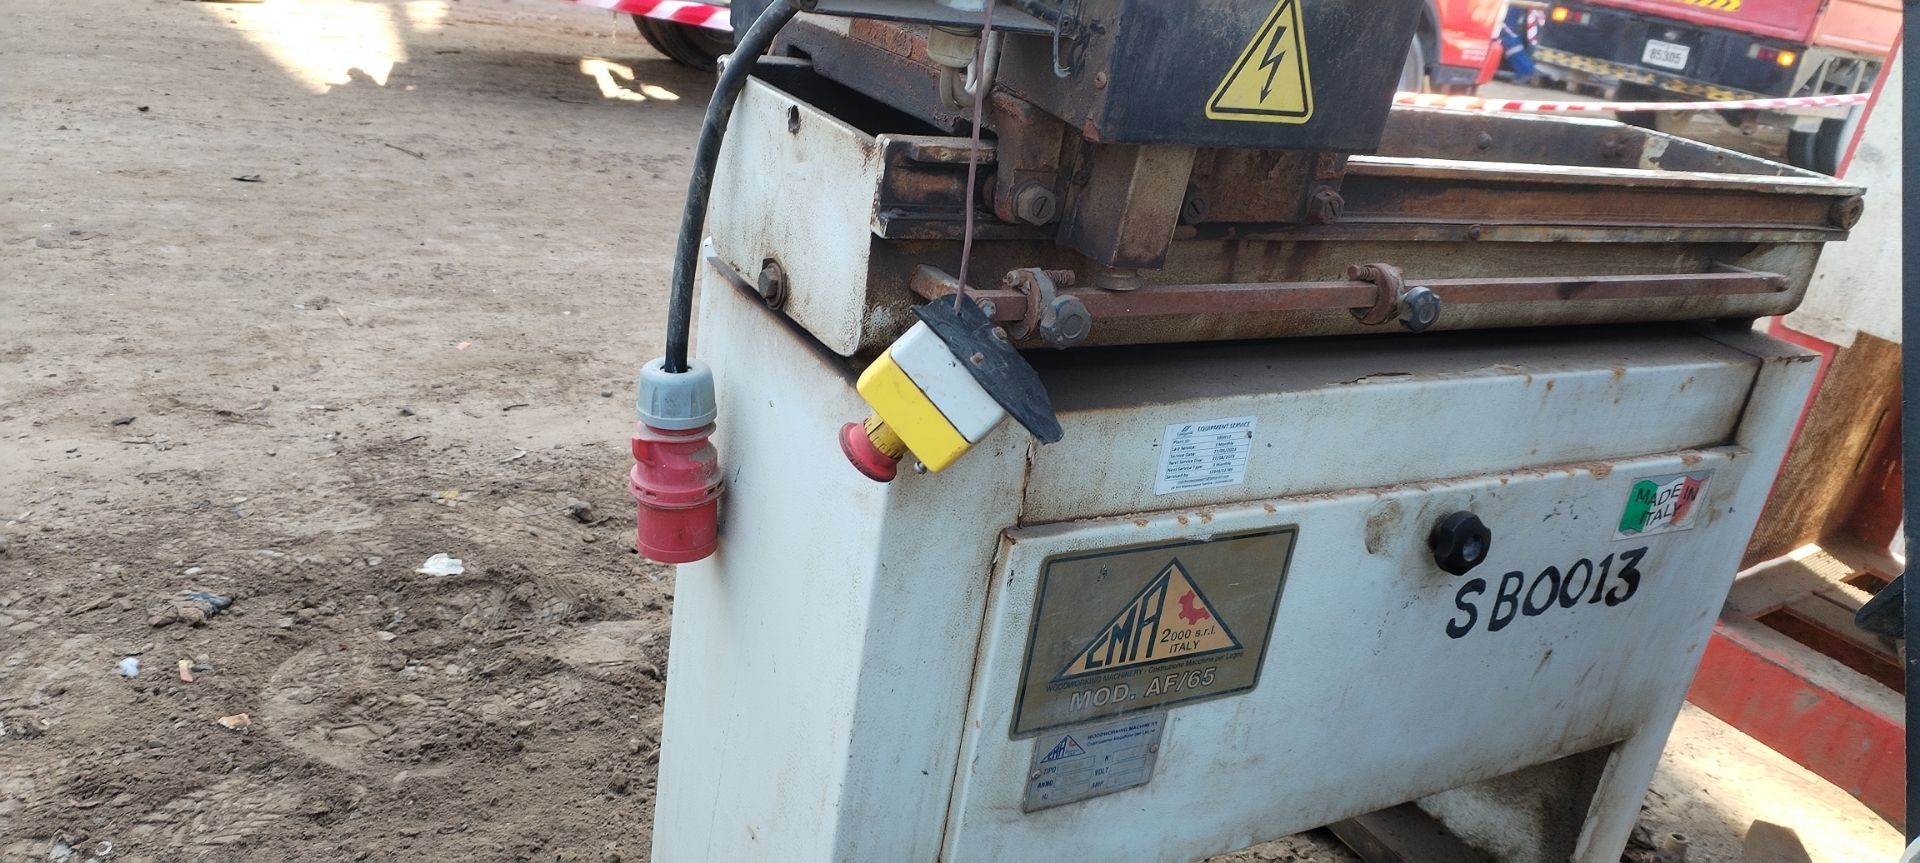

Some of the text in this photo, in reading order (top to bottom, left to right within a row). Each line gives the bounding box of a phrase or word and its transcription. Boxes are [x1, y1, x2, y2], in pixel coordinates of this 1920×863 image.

[1650, 48, 1682, 64] 85305
[1198, 423, 1229, 431] EQUIPMENT
[1635, 483, 1699, 507] MADE IN
[1639, 503, 1683, 527] ITALY
[1160, 625, 1216, 644] 2000 s.r.l.
[1169, 640, 1201, 654] ITALY
[1045, 676, 1102, 693] WOODWORKING
[1102, 668, 1144, 683] MACHINERY
[1149, 660, 1185, 674] Costruzione
[1185, 655, 1214, 669] Macchine
[1214, 653, 1226, 663] per
[1226, 650, 1245, 661] Legno
[1069, 666, 1218, 713] MOD. AF/65
[1043, 766, 1057, 776] TIPO
[1094, 766, 1109, 777] VOLT
[1036, 780, 1054, 790] ANNO
